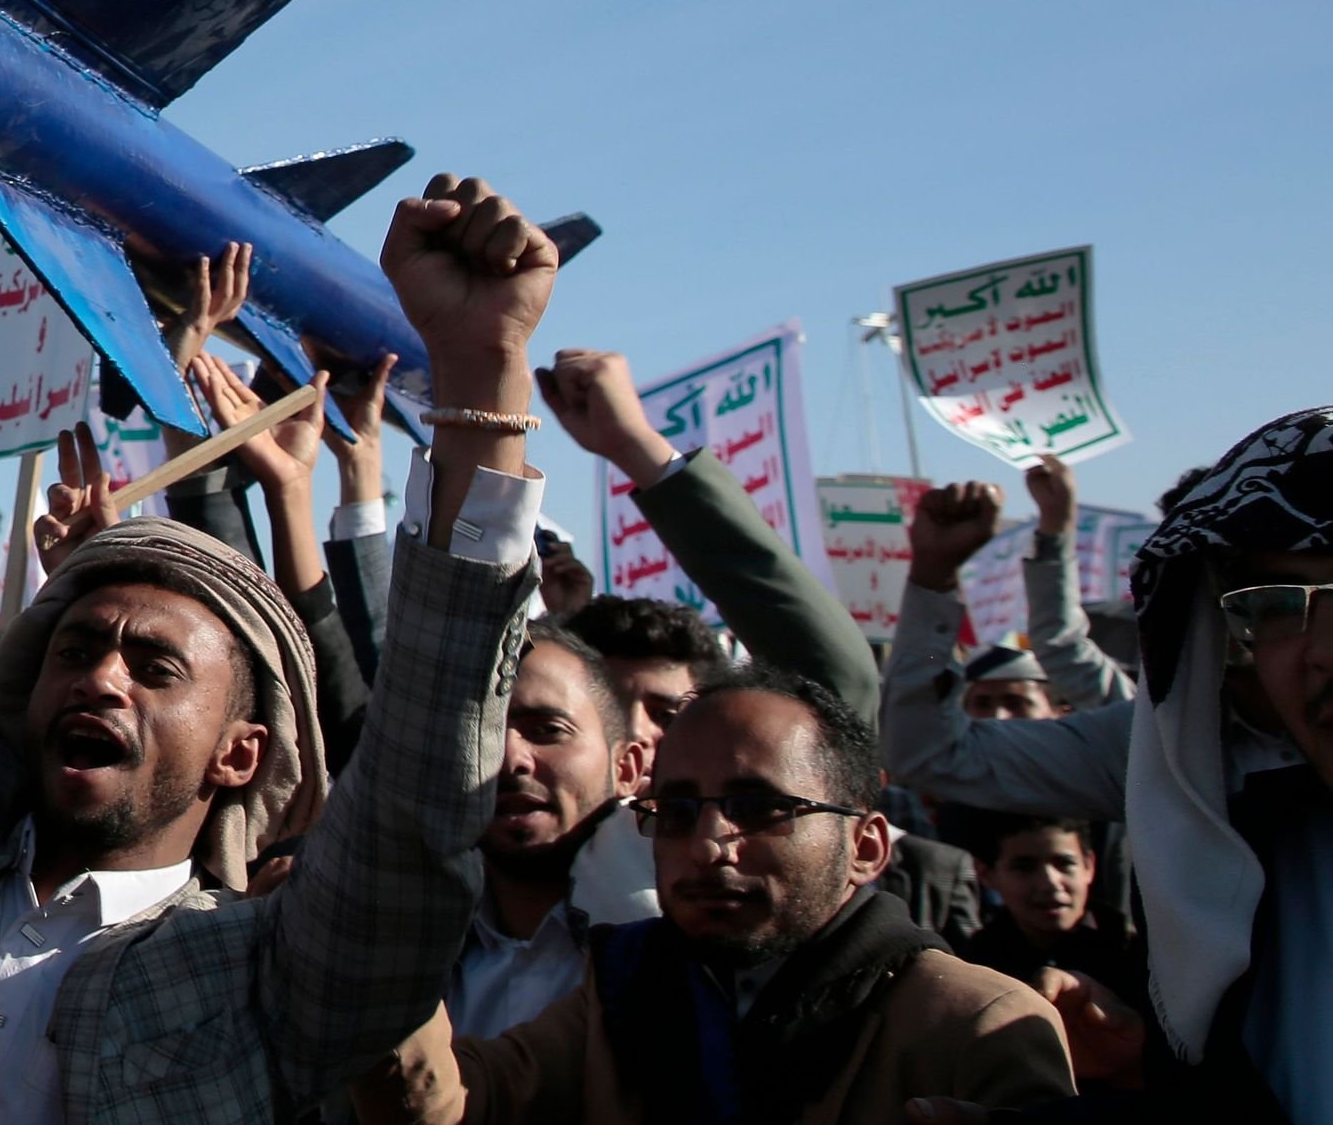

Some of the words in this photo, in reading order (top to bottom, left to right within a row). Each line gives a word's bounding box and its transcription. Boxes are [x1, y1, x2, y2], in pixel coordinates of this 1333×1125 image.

[913, 274, 1009, 330] أكبر
[1013, 265, 1077, 299] الله
[658, 381, 707, 438] أك
[715, 361, 772, 417] الله
